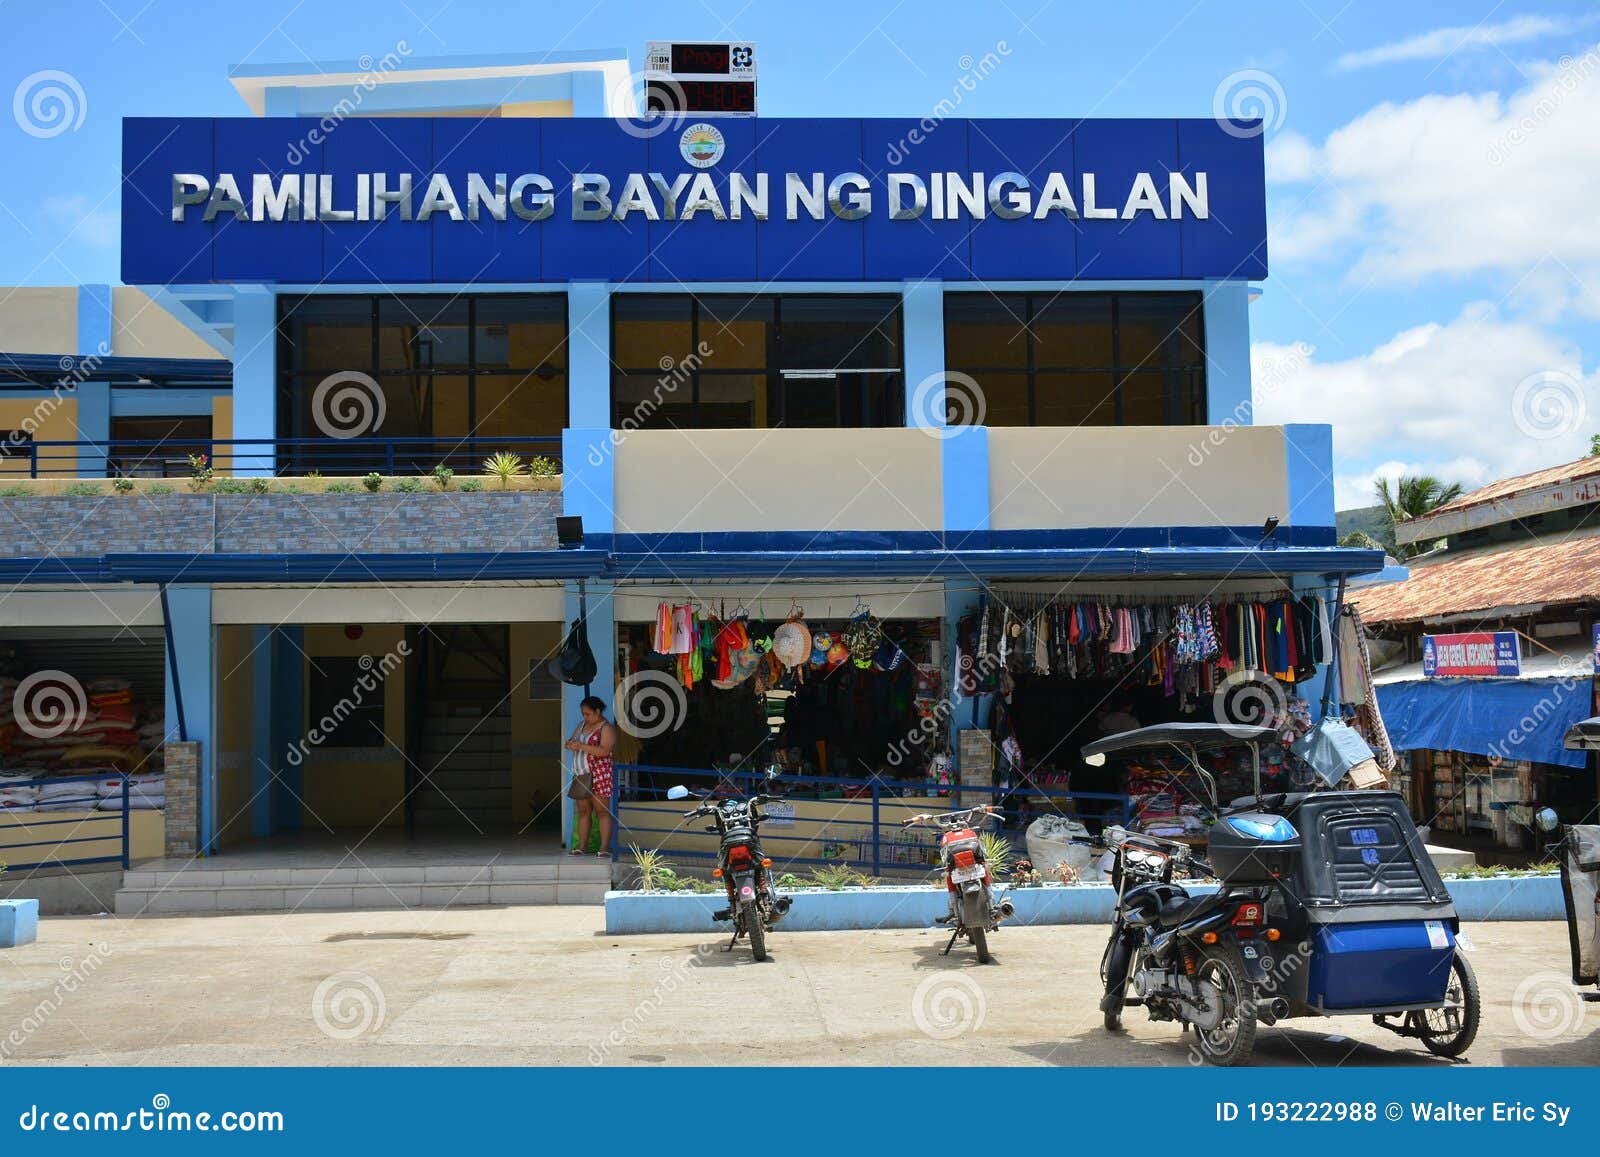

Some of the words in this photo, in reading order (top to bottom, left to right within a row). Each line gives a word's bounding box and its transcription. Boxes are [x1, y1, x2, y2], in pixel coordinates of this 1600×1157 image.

[171, 172, 556, 222] PAMILIHANG
[571, 172, 769, 222] BAYAN
[785, 171, 873, 221] NG
[887, 171, 1210, 221] DINGALAN
